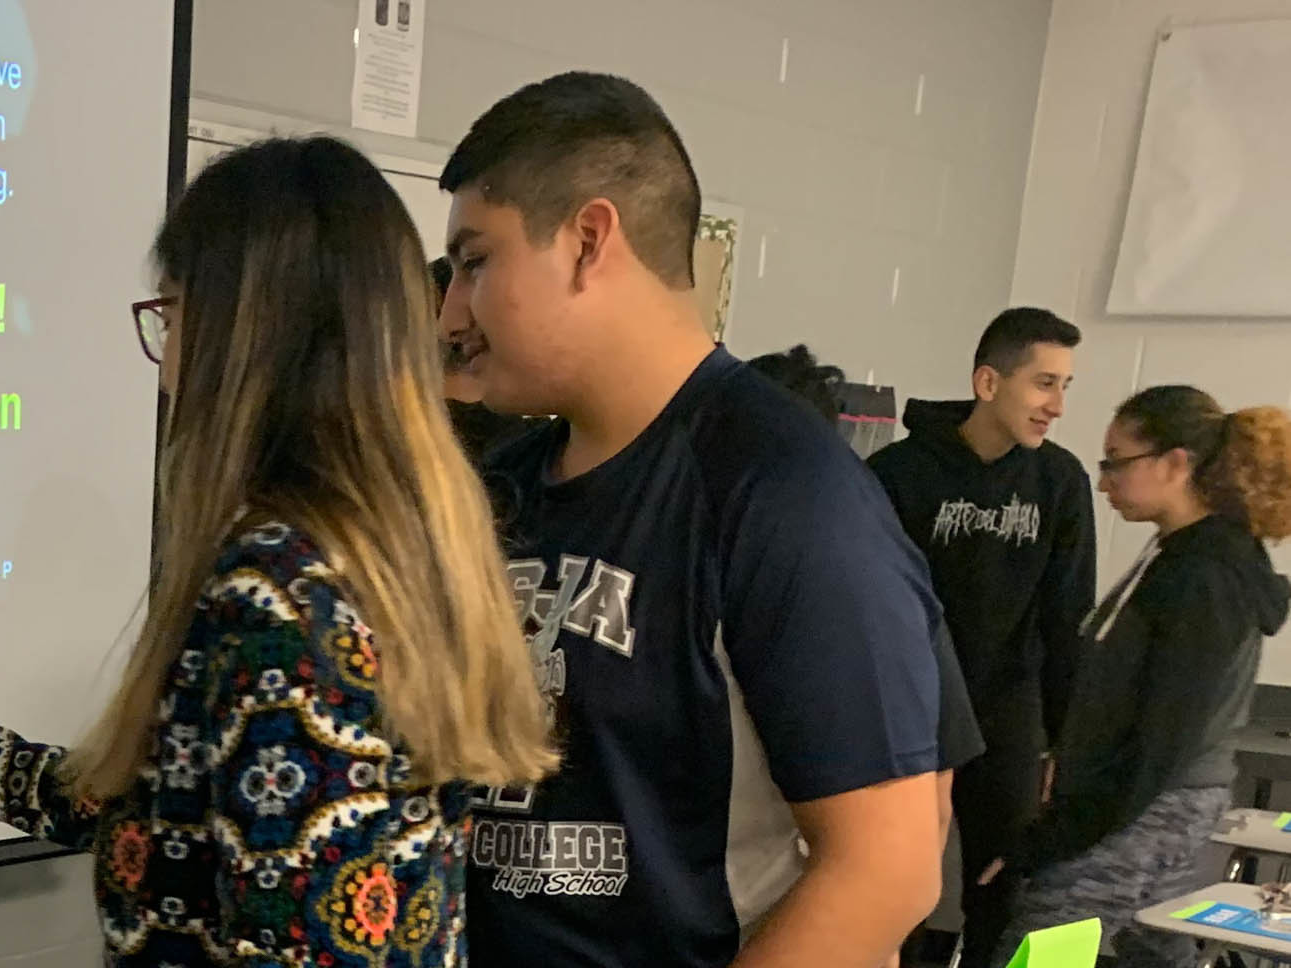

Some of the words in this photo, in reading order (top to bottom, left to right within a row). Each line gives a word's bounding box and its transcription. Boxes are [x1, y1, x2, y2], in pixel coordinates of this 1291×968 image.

[3, 560, 13, 579] P
[471, 819, 628, 873] COLLEGE
[491, 866, 545, 899] High
[543, 869, 629, 897] School
